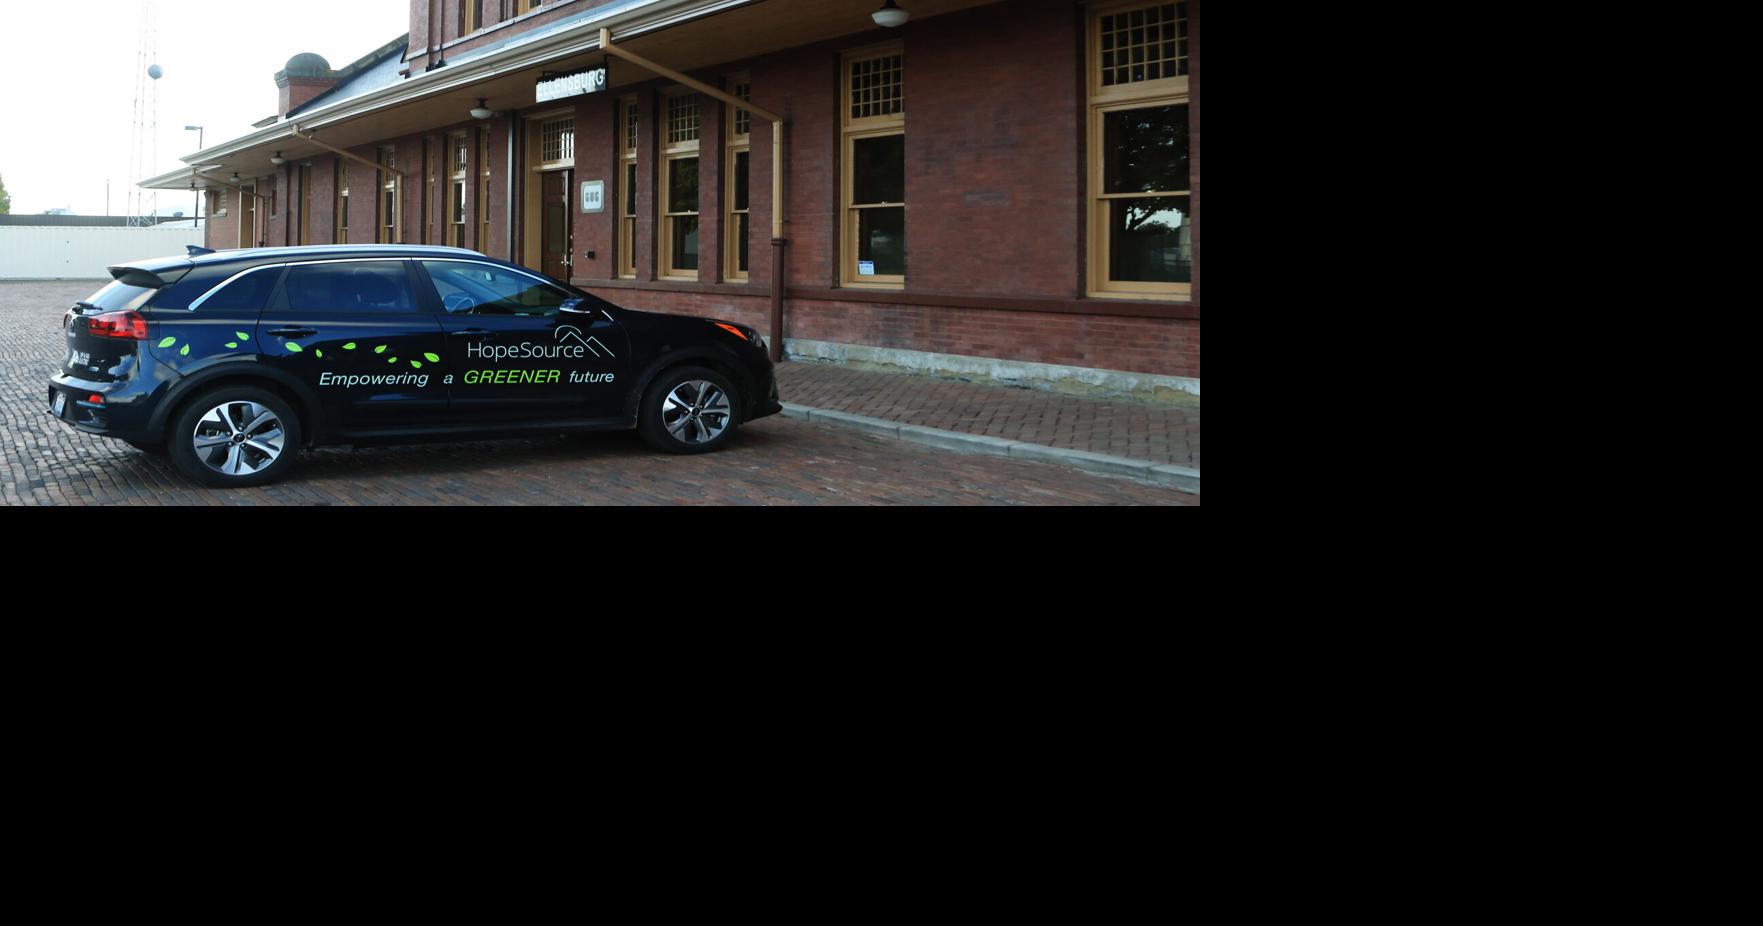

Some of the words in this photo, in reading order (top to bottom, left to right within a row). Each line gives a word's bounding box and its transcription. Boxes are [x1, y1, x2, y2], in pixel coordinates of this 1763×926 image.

[536, 68, 604, 98] ELLENSBURG
[467, 341, 584, 362] HopeSource
[319, 371, 429, 388] Empowering
[443, 374, 454, 384] a
[464, 369, 560, 384] GREENER
[569, 370, 615, 383] future
